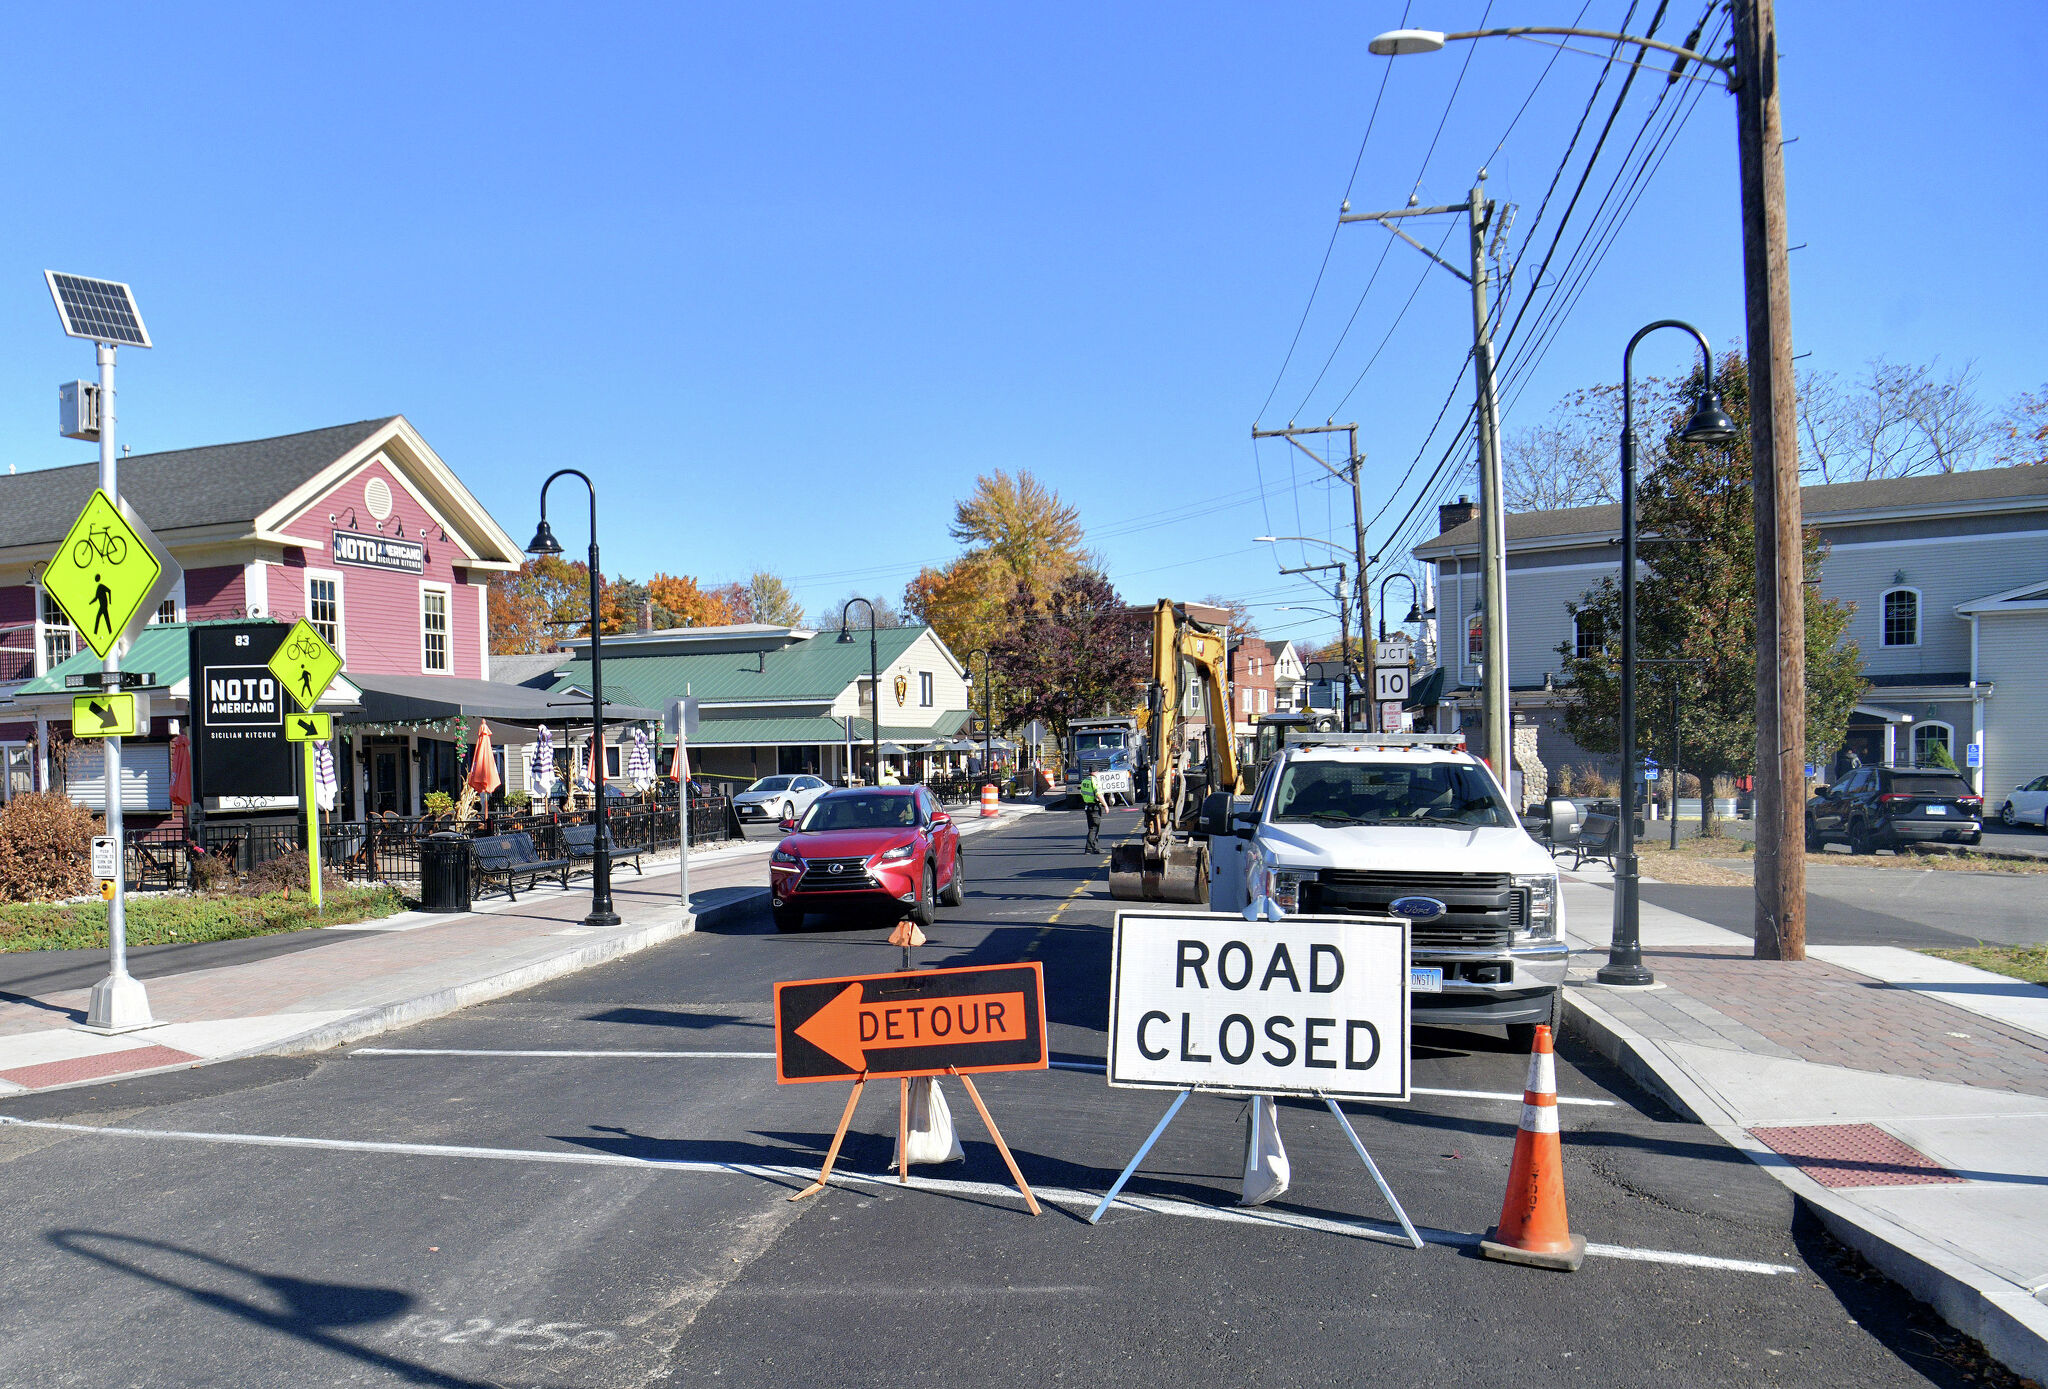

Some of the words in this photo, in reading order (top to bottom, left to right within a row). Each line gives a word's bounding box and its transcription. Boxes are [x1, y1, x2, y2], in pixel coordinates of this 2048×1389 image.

[336, 537, 377, 562] NOTO
[377, 542, 421, 560] AMERICANO
[235, 635, 250, 647] 83
[1380, 648, 1404, 659] JCT
[211, 678, 275, 702] NOTO
[1380, 674, 1404, 694] 10
[211, 702, 275, 714] AMERICANO
[245, 731, 277, 739] KITCHEN
[1100, 773, 1121, 782] ROAD
[1099, 781, 1126, 790] LOSED
[1404, 903, 1431, 914] Ford
[1175, 939, 1345, 993] ROAD
[1411, 974, 1435, 986] ONST1
[859, 1001, 1007, 1042] DETOUR
[1136, 1010, 1381, 1071] CLOSED
